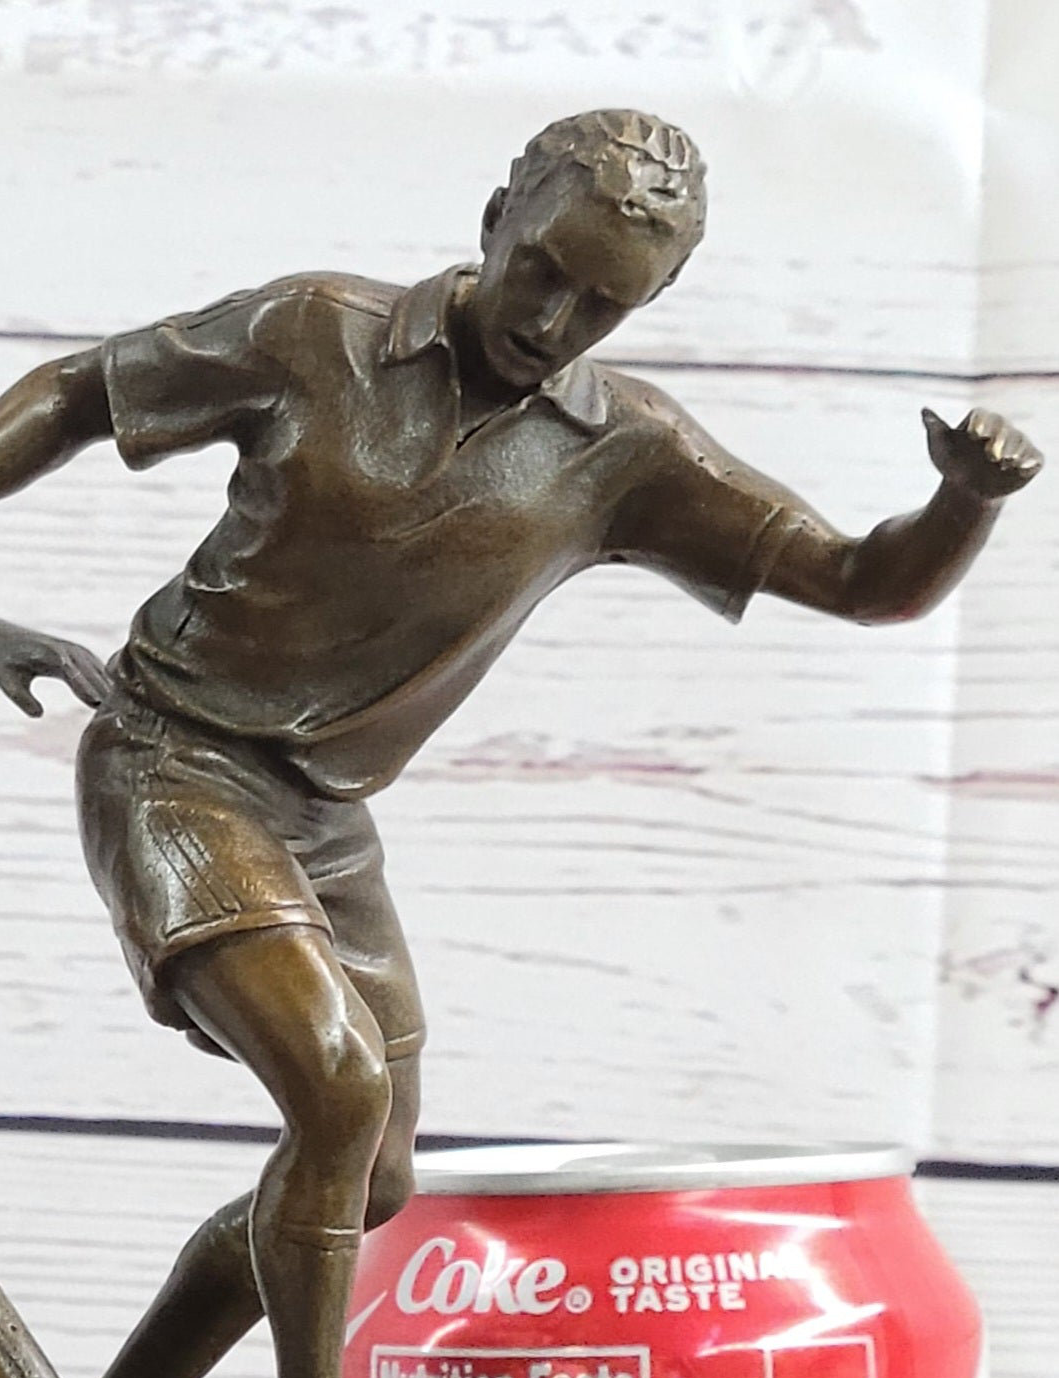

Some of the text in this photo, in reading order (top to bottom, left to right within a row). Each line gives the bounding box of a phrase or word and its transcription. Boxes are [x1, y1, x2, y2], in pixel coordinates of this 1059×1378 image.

[396, 1237, 567, 1315] Coke
[610, 1250, 810, 1286] ORIGINA
[609, 1282, 747, 1314] TASTE
